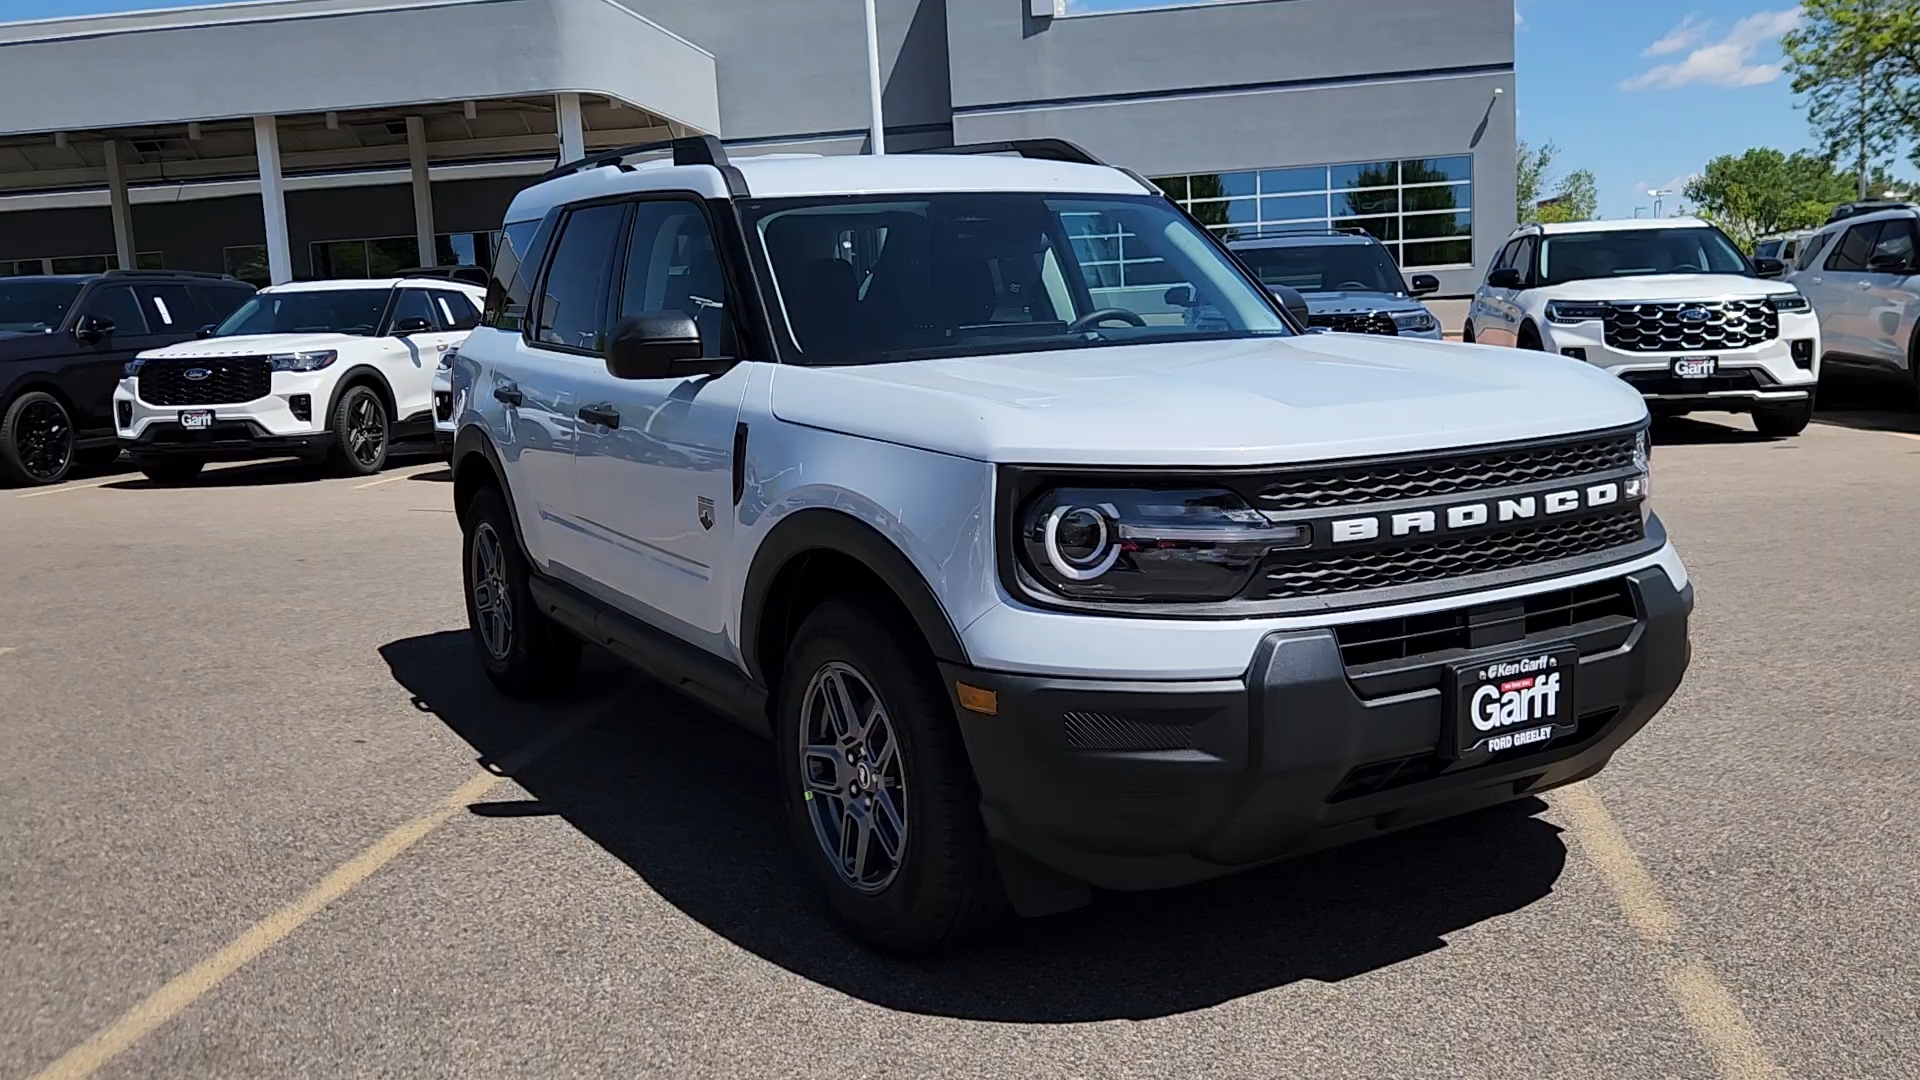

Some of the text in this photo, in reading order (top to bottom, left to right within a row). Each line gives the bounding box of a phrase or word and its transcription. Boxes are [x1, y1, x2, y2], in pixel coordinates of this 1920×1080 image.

[1674, 359, 1715, 375] Garff
[181, 413, 212, 427] Garff
[1331, 482, 1618, 543] BRONCO
[1497, 655, 1549, 678] Ken Garff
[1470, 672, 1560, 731] Garff
[1488, 727, 1552, 752] FORD GREELEY
